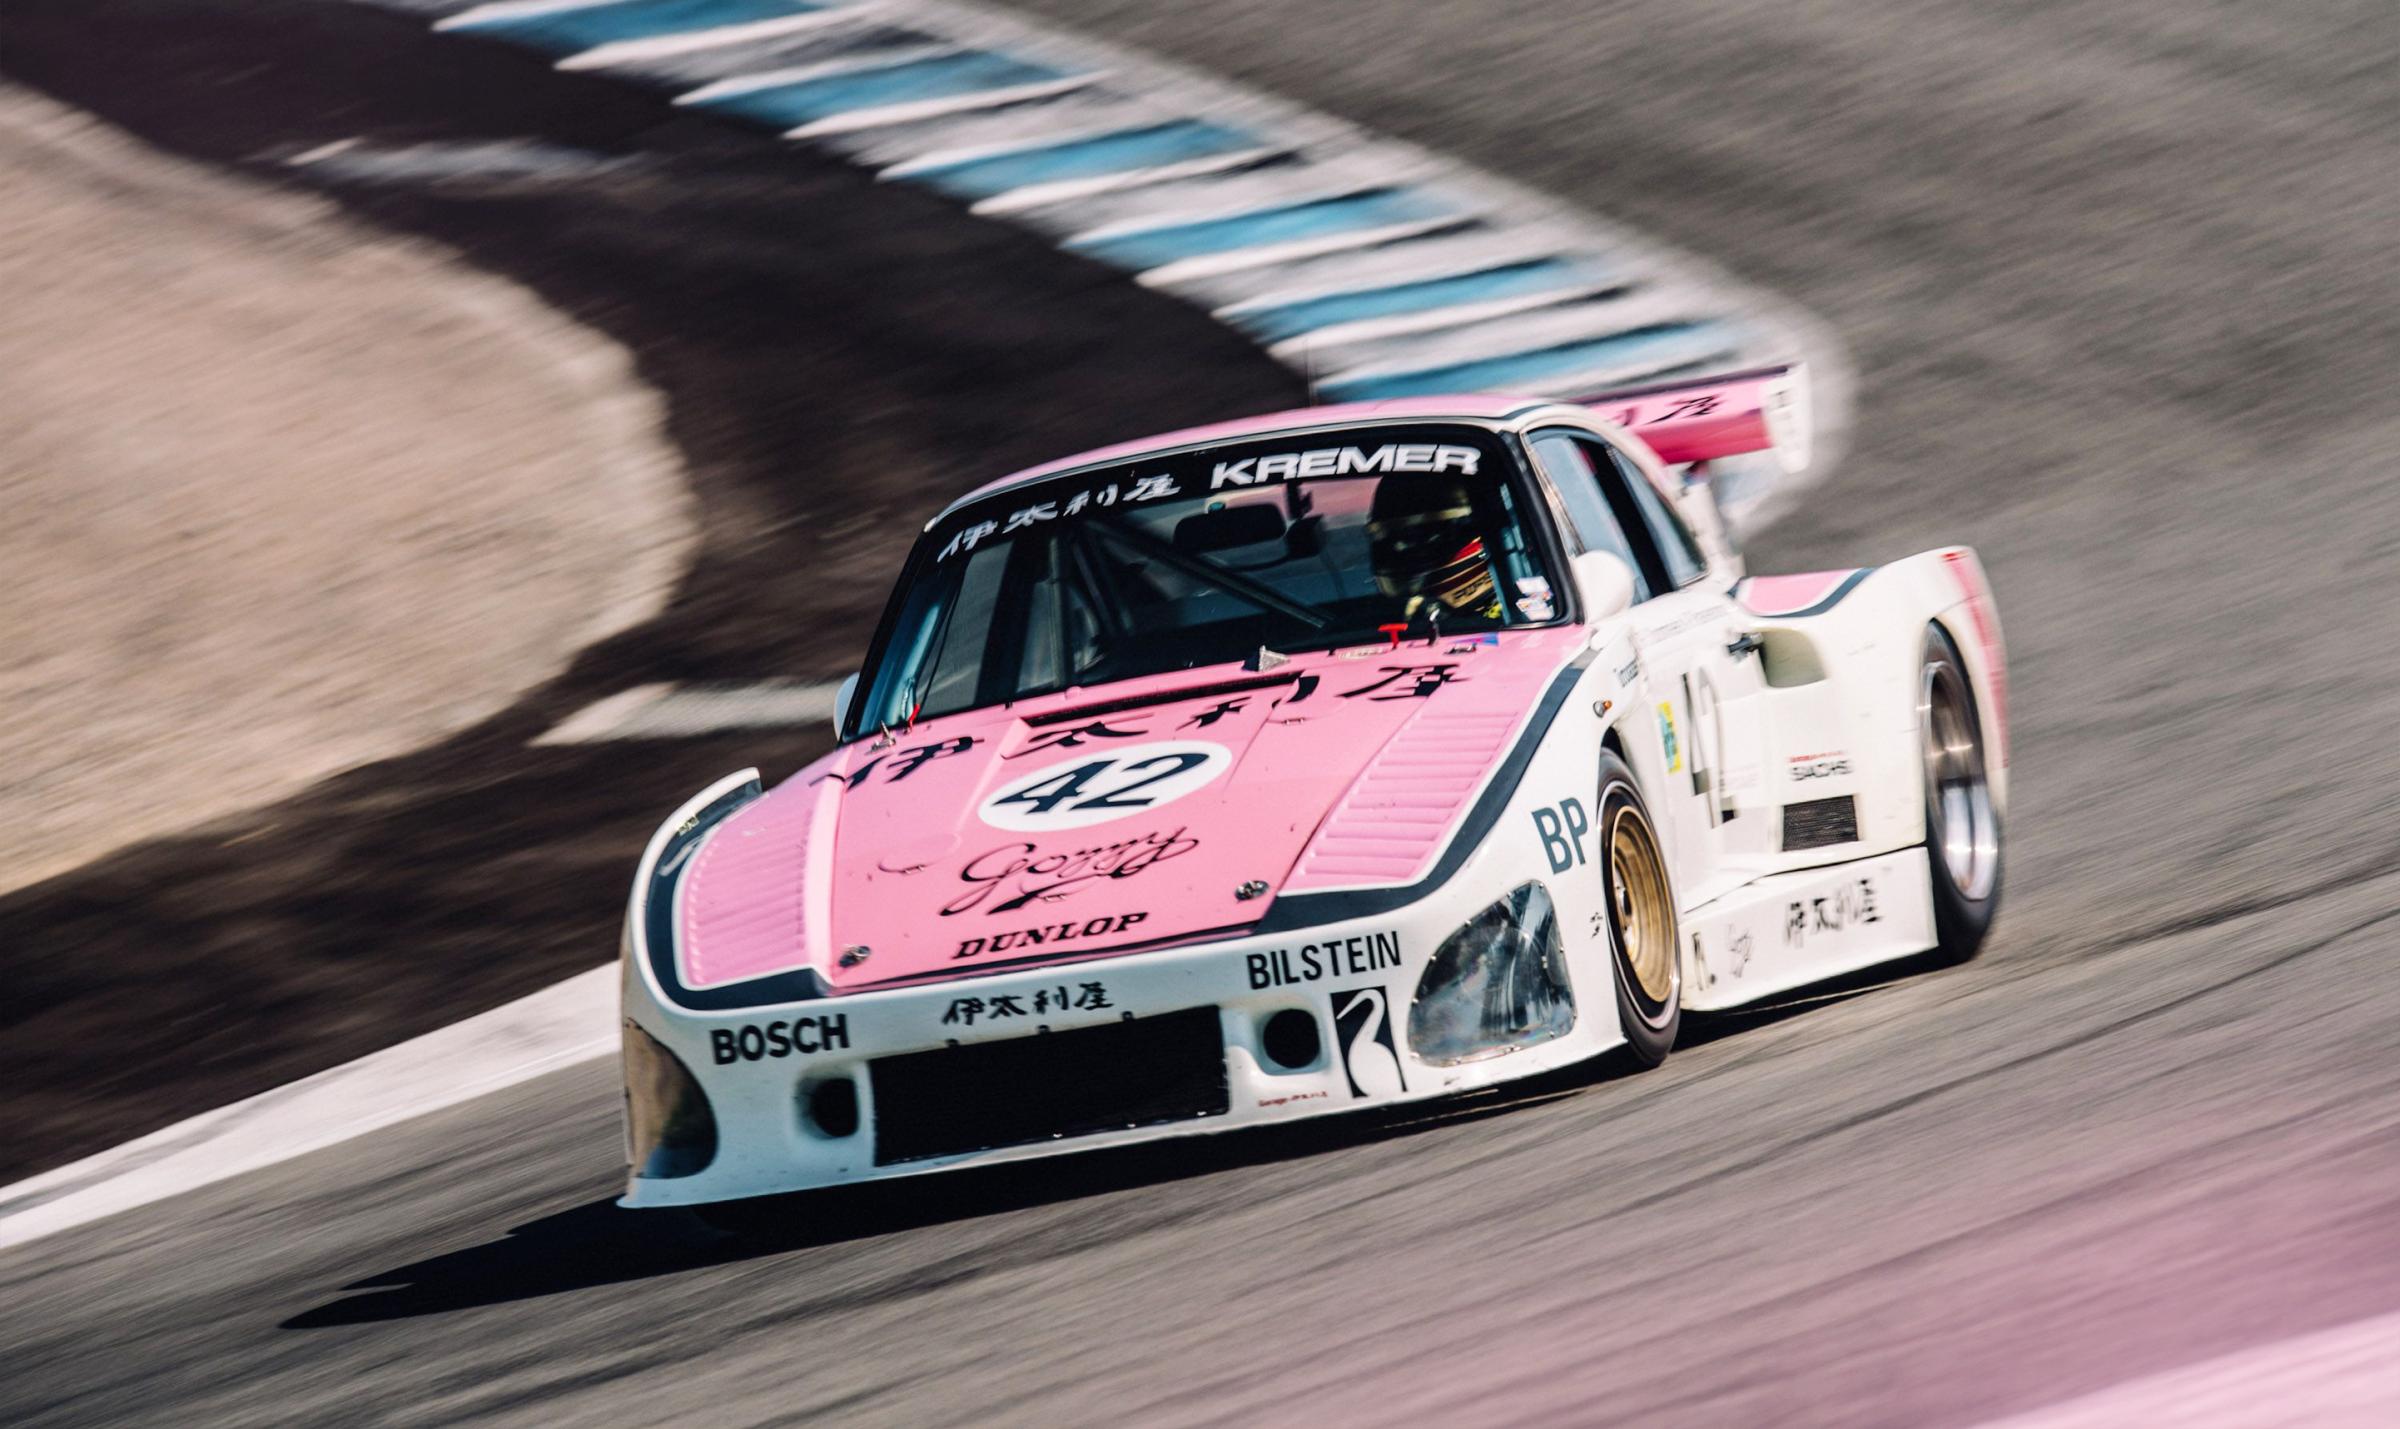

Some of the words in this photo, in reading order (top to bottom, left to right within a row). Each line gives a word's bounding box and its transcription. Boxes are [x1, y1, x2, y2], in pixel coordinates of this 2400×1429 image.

[1210, 444, 1482, 490] KREMER
[937, 473, 1182, 563] 伊太利屋
[990, 752, 1210, 814] 42
[1532, 797, 1589, 875] BP
[953, 912, 1149, 960] DUNLOP
[1246, 931, 1402, 991] BILSTEIN
[941, 982, 1114, 1026] 伊太利屋
[710, 1014, 850, 1065] BOSCH
